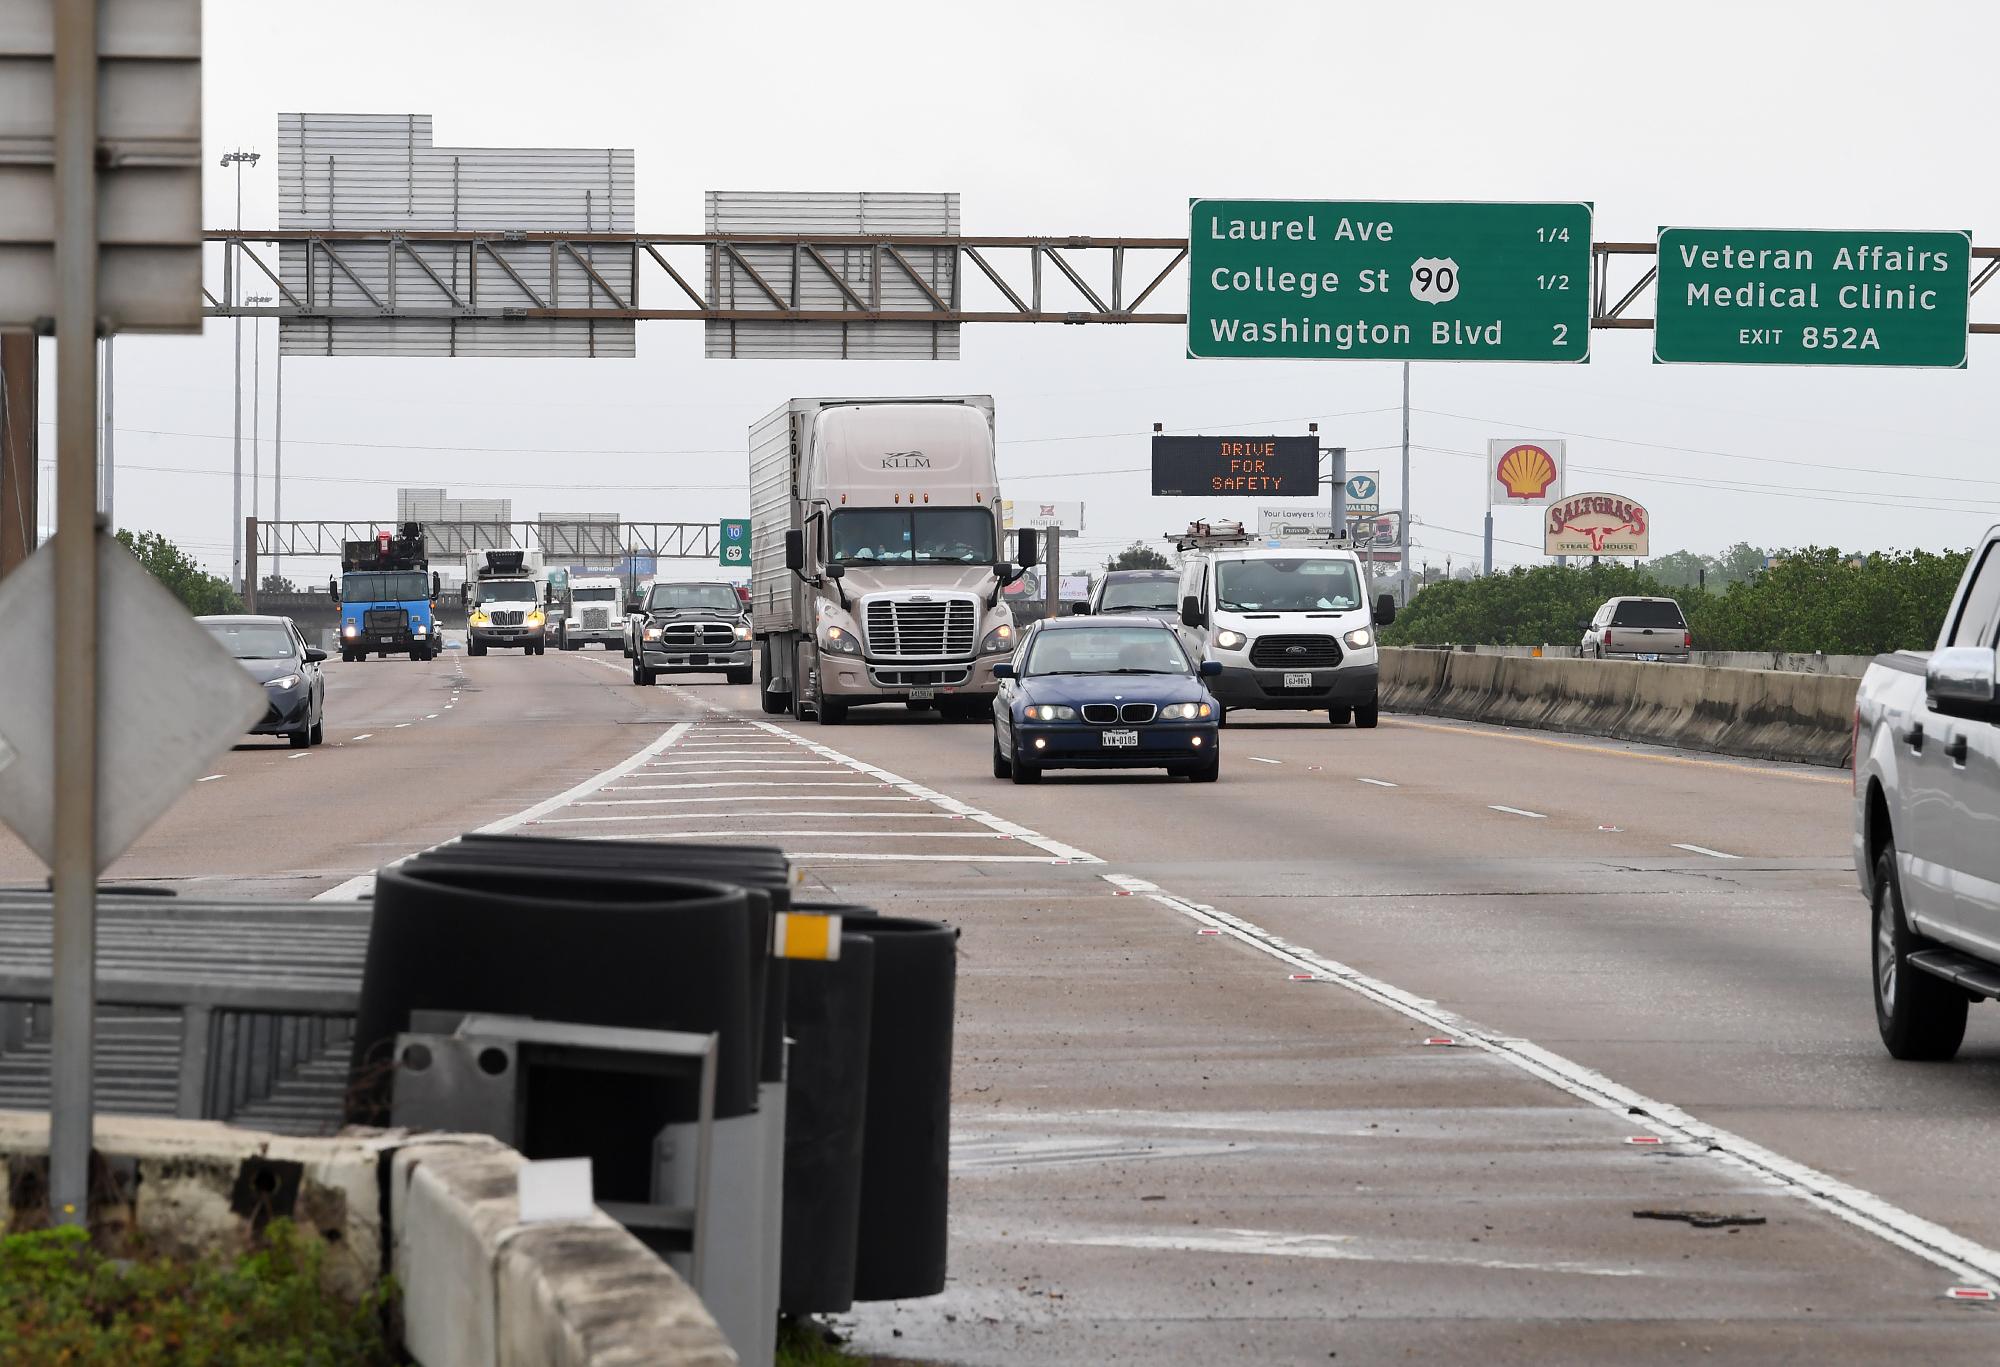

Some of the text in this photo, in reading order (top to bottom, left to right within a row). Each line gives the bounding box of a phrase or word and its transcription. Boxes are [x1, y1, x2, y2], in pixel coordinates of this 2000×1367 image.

[1211, 215, 1395, 242] Laurel Ave
[1535, 226, 1571, 243] 1/4
[1679, 244, 1950, 273] Veteran Affairs
[1210, 266, 1391, 299] College St
[1415, 267, 1455, 294] 90
[1535, 274, 1571, 291] 1/2
[1686, 281, 1938, 311] Medical Clinic
[1210, 317, 1504, 351] Washington Blvd
[1551, 322, 1569, 347] 2
[1738, 326, 1881, 351] EXIT 852A
[1220, 441, 1277, 457] DRIVE
[881, 457, 932, 469] KLLM
[1230, 458, 1266, 474] FOR
[1211, 475, 1284, 491] SAFETY
[1263, 510, 1281, 518] Your
[1282, 510, 1315, 519] Lawyers
[1345, 504, 1378, 512] VALERO
[1548, 496, 1646, 536] SALTGRASS
[728, 528, 740, 538] 10
[727, 548, 741, 558] 69
